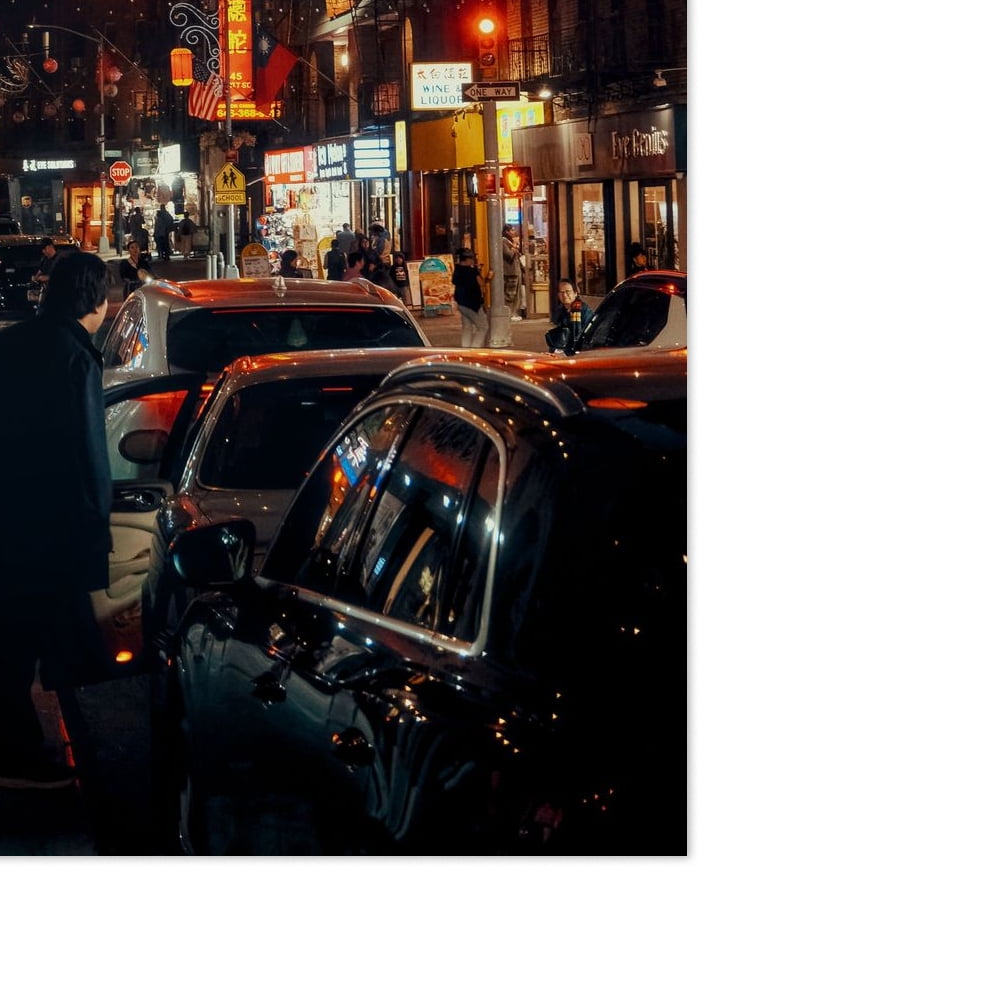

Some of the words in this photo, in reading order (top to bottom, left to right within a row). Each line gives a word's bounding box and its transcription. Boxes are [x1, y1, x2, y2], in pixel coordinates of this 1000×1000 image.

[422, 84, 450, 93] WINE
[470, 88, 487, 96] ONE
[494, 88, 513, 96] WAY
[111, 168, 130, 177] STOP
